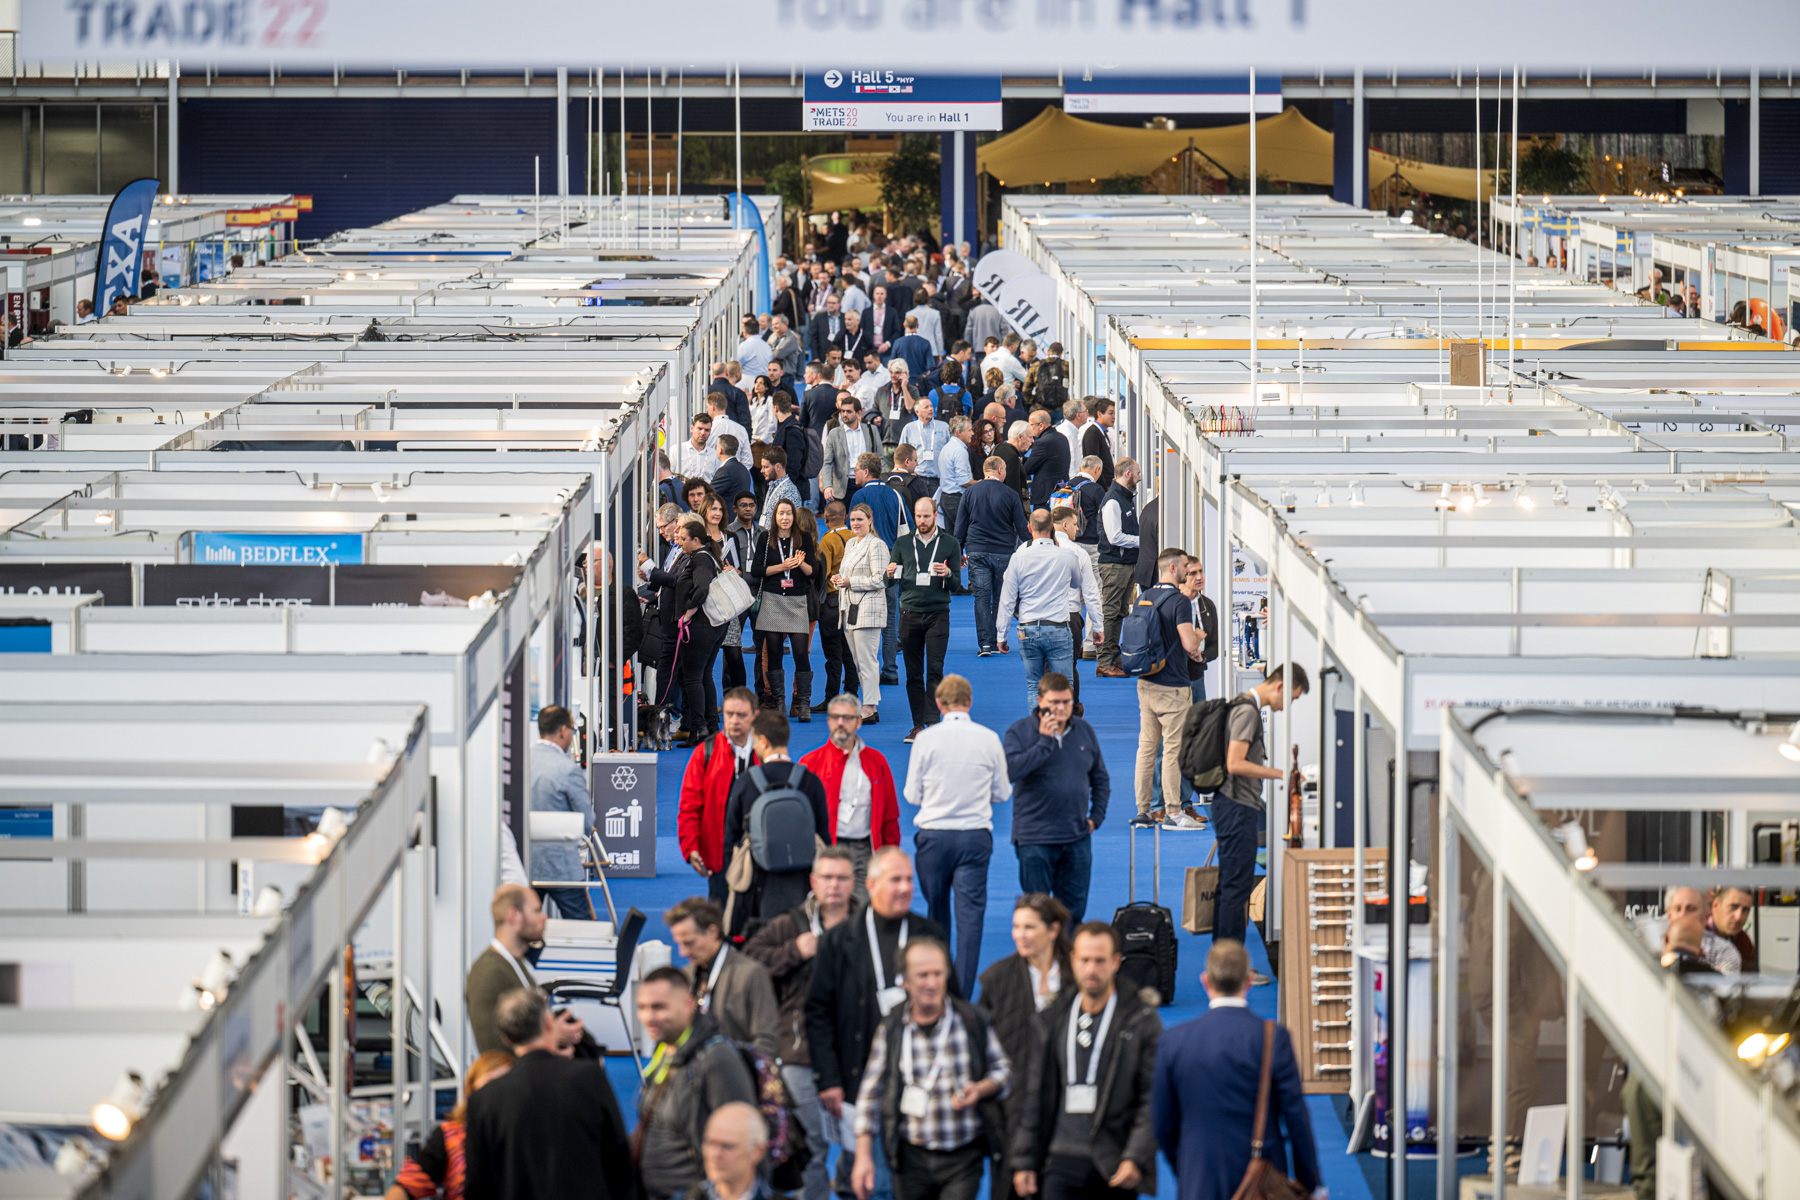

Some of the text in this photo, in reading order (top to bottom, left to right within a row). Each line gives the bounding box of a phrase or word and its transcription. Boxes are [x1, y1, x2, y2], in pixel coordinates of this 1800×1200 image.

[66, 0, 256, 47] TRADE
[851, 70, 882, 83] Hall
[885, 71, 894, 83] 5
[816, 108, 858, 117] METS 20
[886, 113, 969, 122] You are in Hall 1
[813, 118, 858, 127] TRADE 22
[1663, 422, 1677, 432] 2
[1699, 422, 1713, 432] 3
[241, 546, 329, 562] BEDFLEX
[608, 849, 640, 864] rai
[1625, 904, 1661, 920] ACYL
